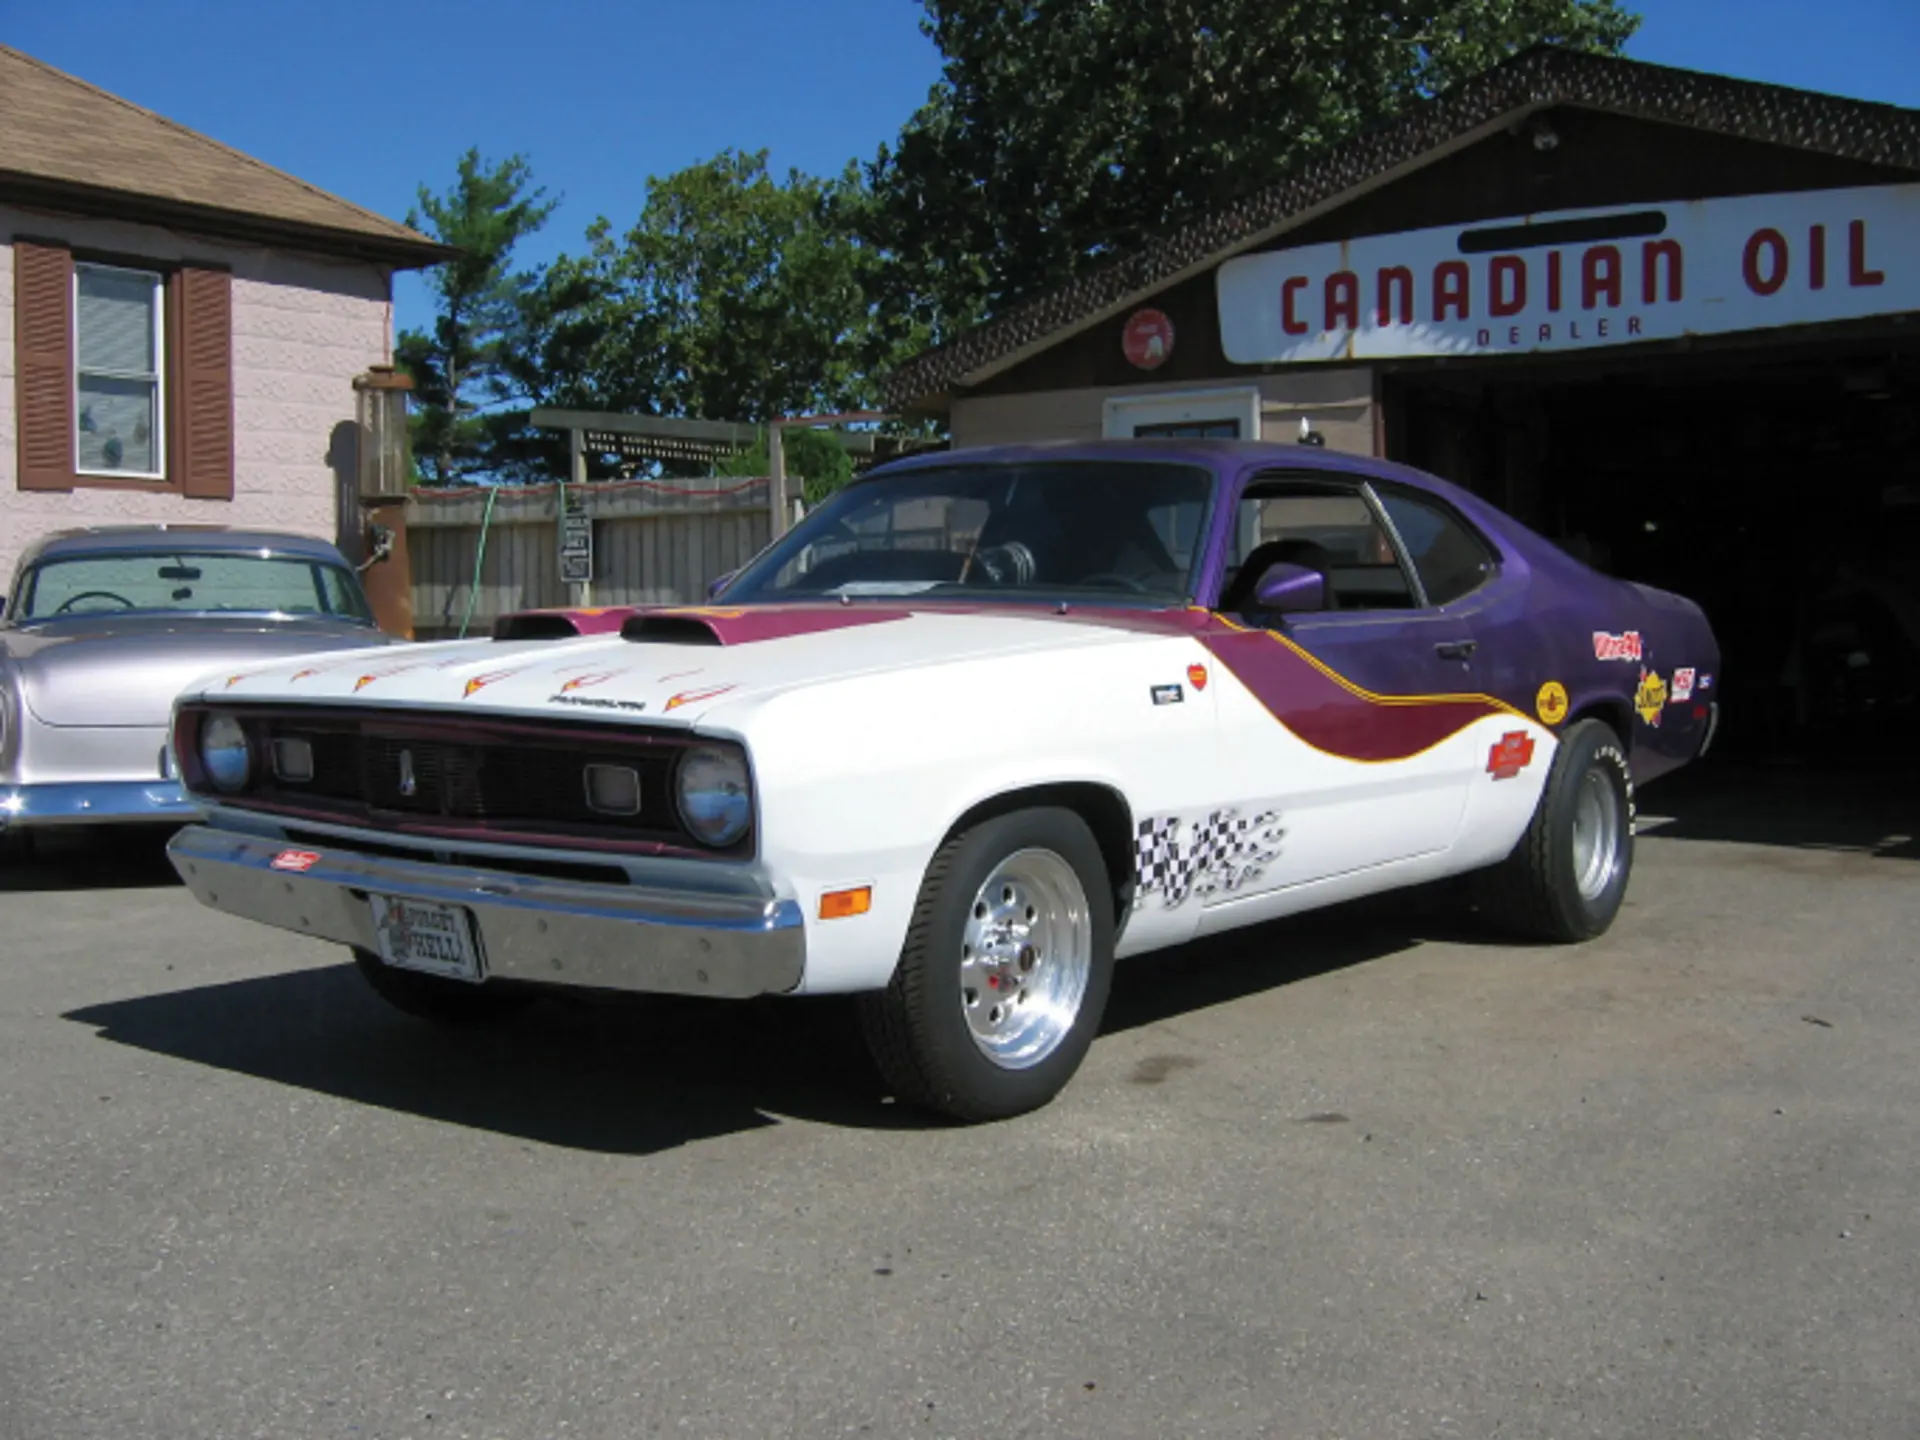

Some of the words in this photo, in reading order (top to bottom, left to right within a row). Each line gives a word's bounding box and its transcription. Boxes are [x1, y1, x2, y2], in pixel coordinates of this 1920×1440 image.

[1281, 238, 1683, 335] CANADIAN
[1741, 219, 1885, 296] OIL
[1477, 315, 1643, 346] DEALER
